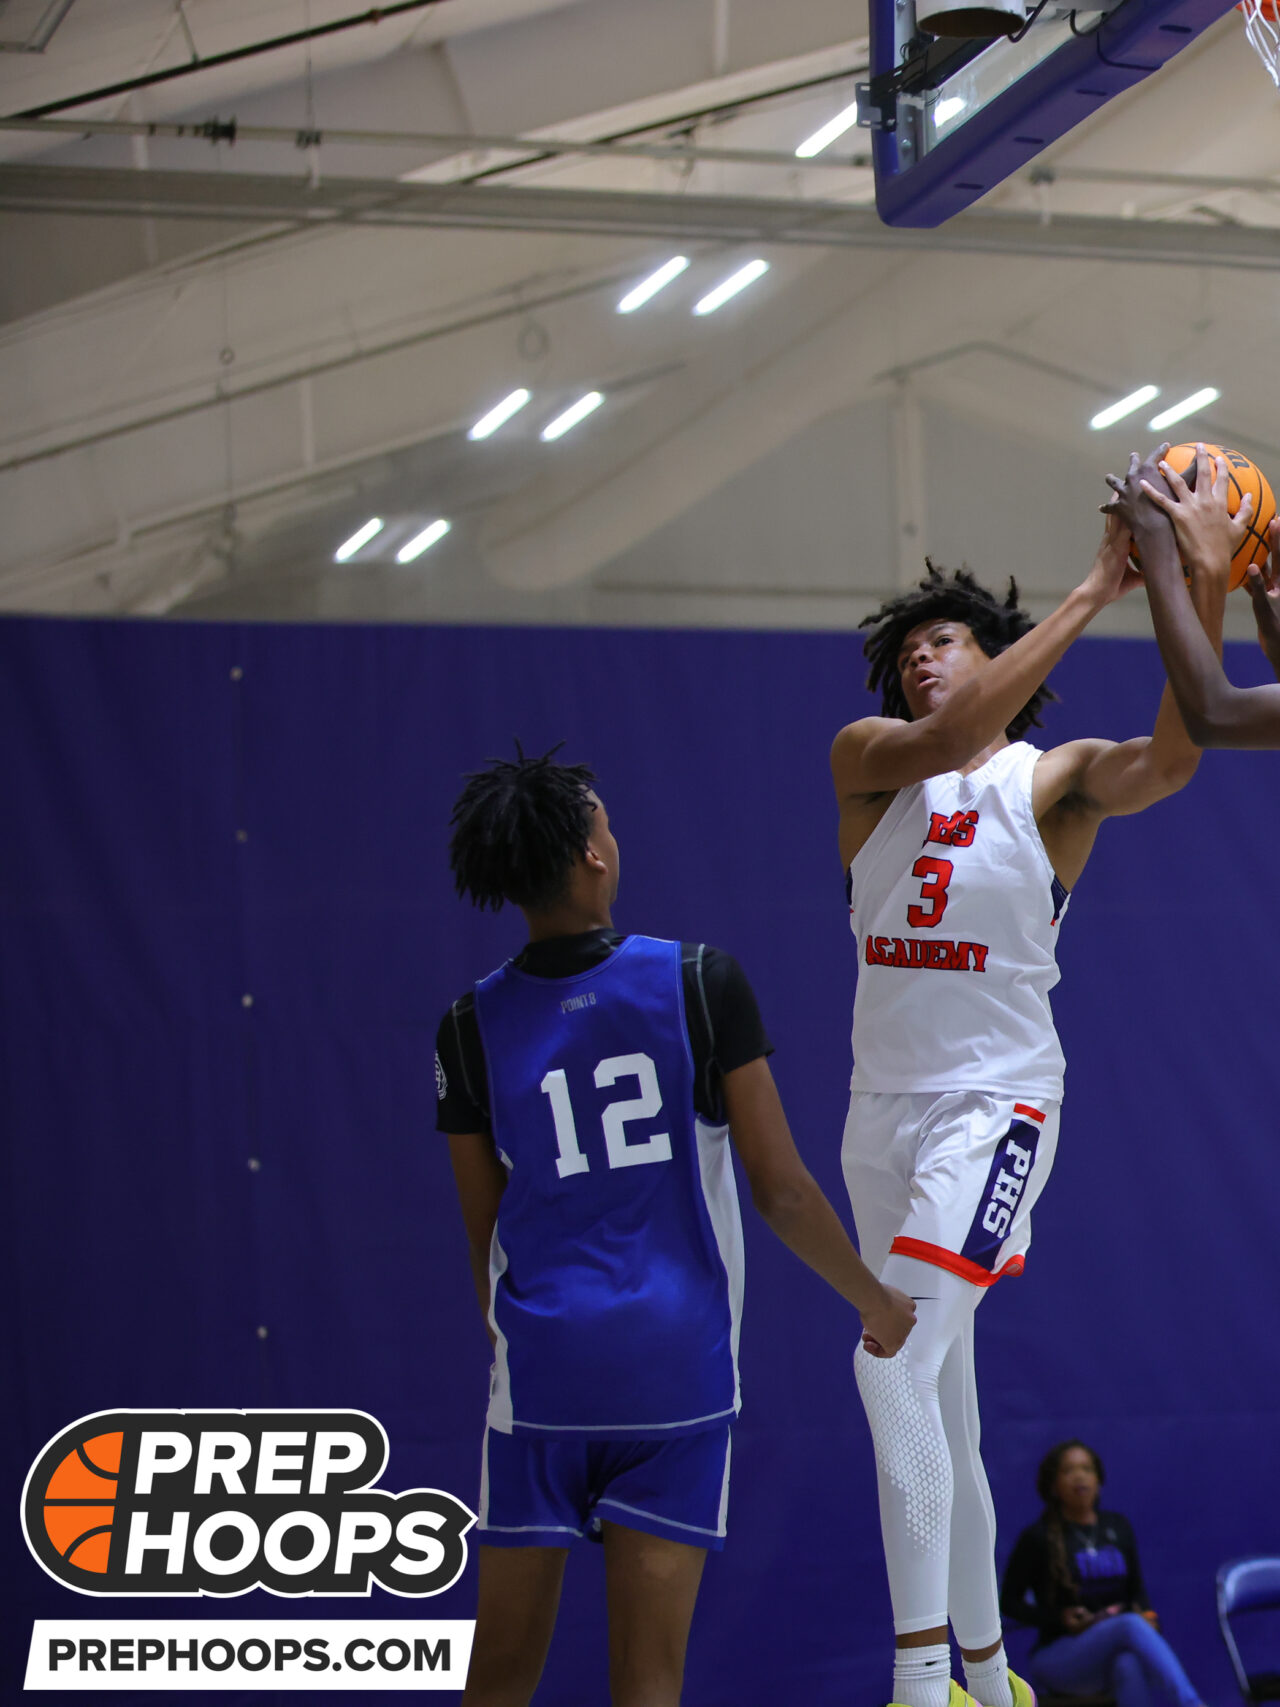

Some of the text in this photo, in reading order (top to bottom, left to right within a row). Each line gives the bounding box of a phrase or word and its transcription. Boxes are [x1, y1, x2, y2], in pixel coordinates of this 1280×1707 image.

[906, 855, 955, 928] 3
[541, 1052, 672, 1178] 12
[981, 1139, 1032, 1239] PHS
